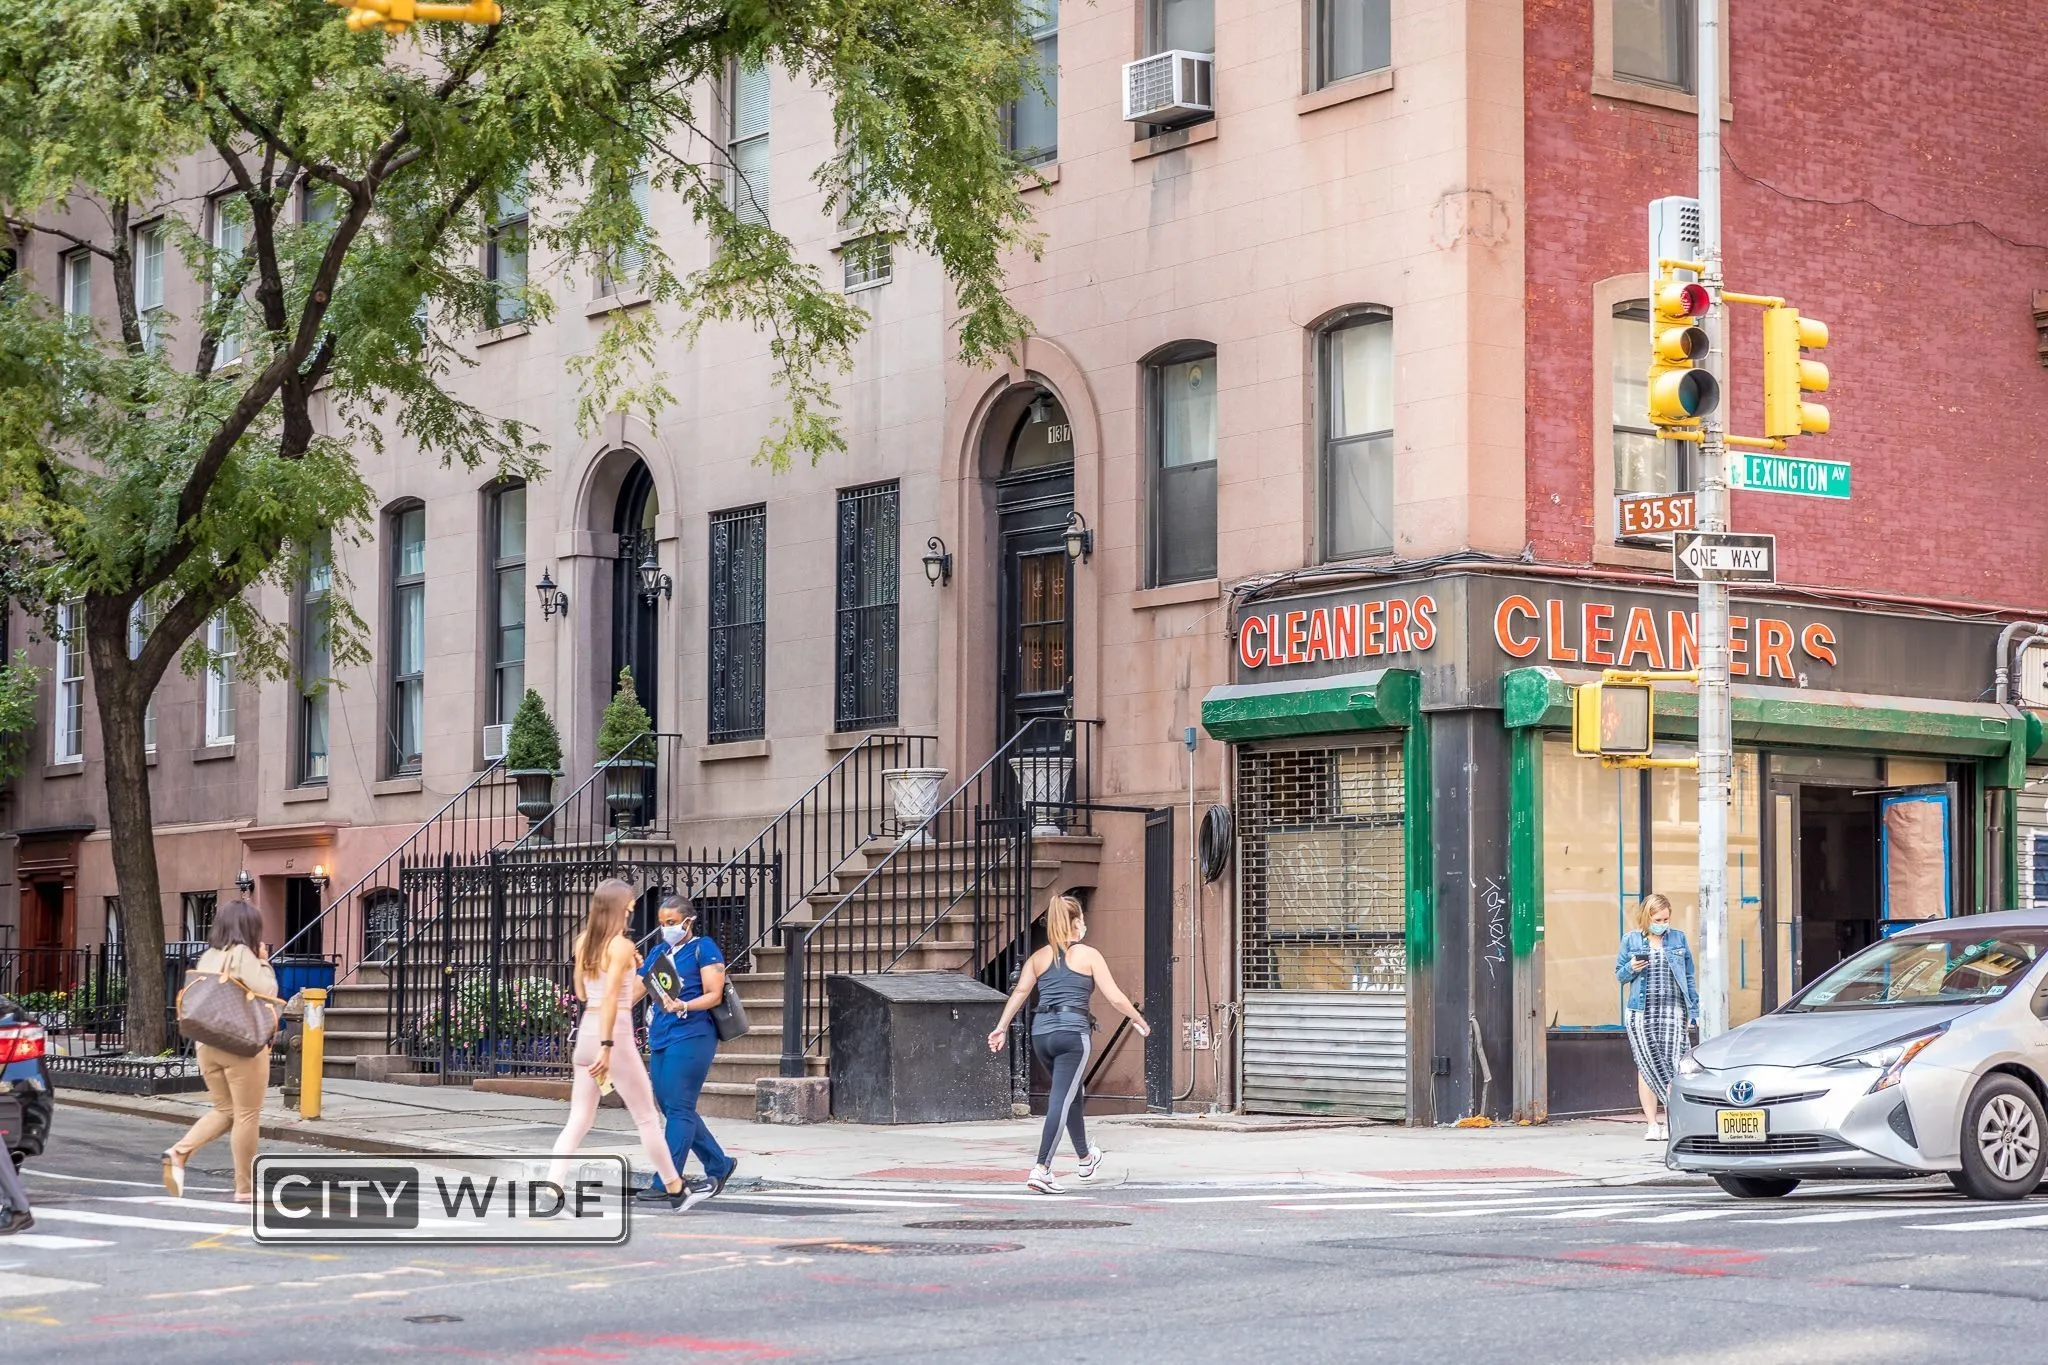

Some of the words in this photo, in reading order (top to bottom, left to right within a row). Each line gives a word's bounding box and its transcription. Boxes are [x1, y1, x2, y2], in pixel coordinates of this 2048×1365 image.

[1047, 424, 1071, 443] 137
[1744, 458, 1828, 491] LEXINGTON
[1832, 466, 1847, 481] AV
[1623, 504, 1637, 530] E
[1639, 501, 1665, 529] 35
[1669, 498, 1693, 527] ST
[1689, 548, 1718, 567] ONE
[1731, 550, 1761, 568] WAY
[1239, 594, 1437, 669] CLEANERS
[1494, 595, 1837, 679] CLEANERS
[1723, 1117, 1759, 1134] DRUBER
